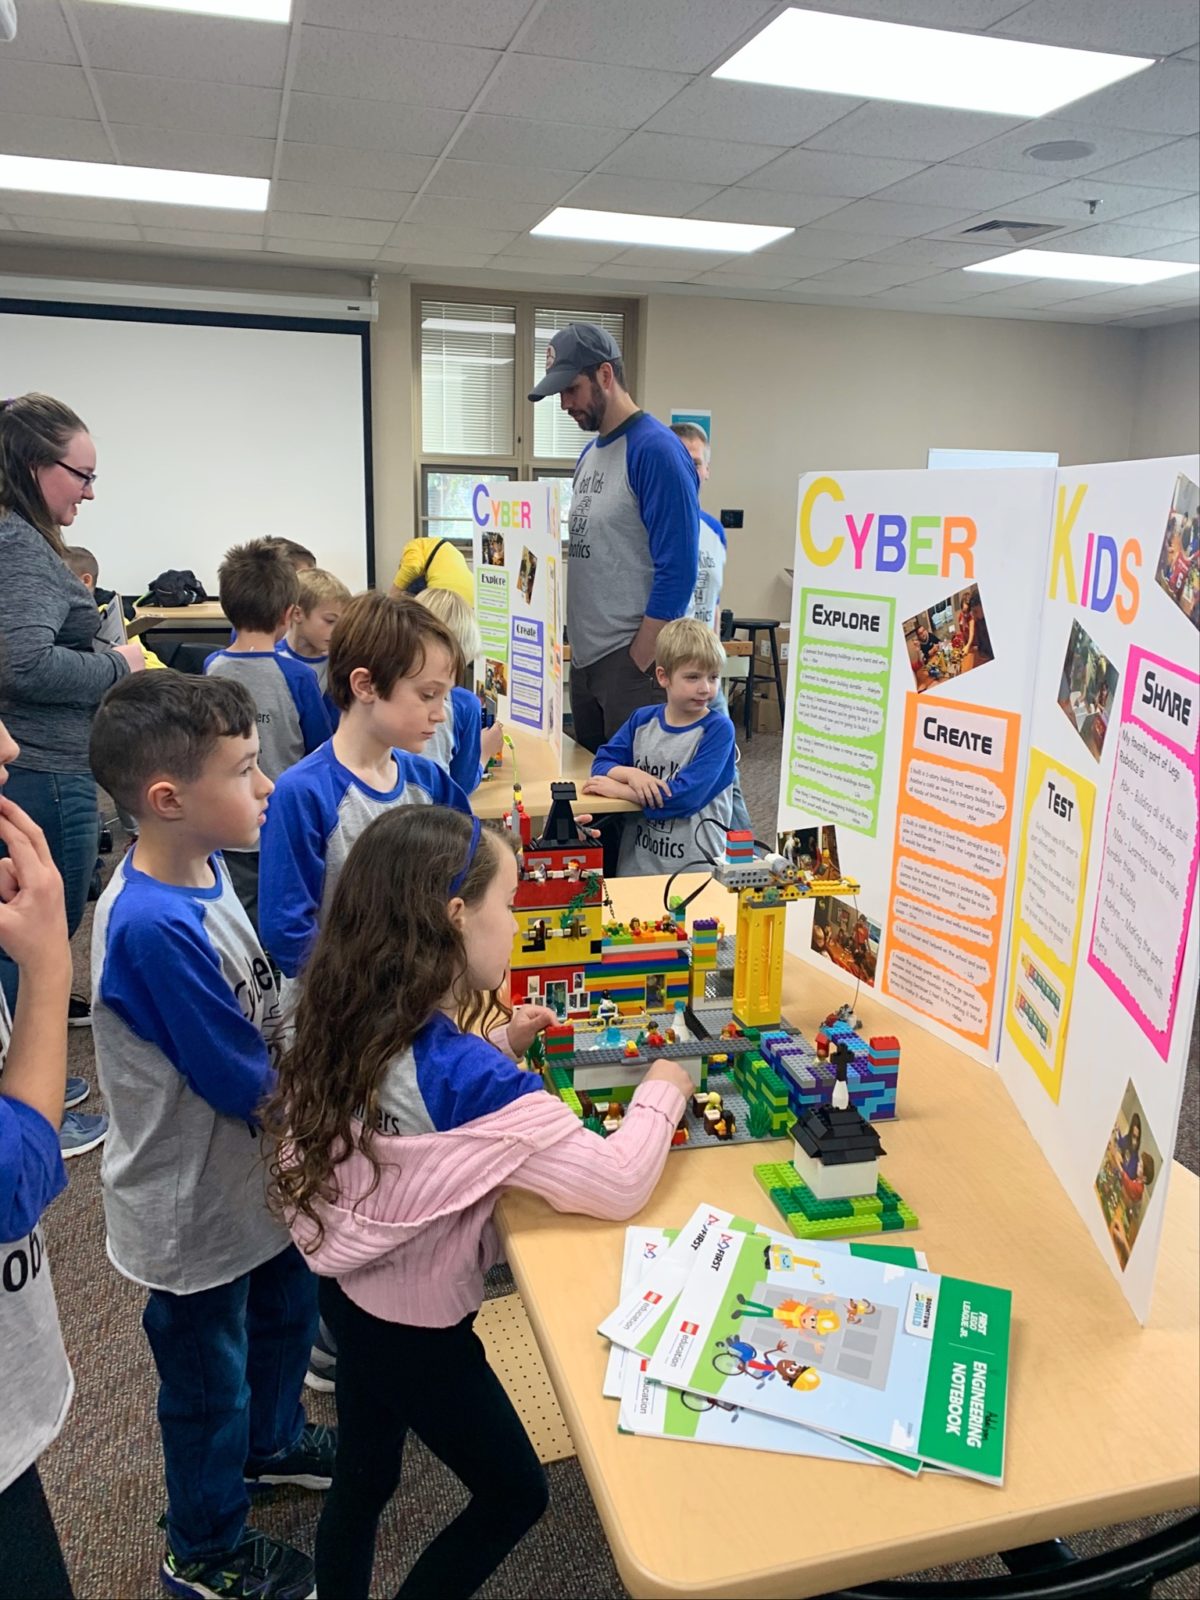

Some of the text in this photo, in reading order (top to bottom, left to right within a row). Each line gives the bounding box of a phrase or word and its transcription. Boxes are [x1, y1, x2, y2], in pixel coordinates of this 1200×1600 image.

[472, 484, 531, 529] CYBER
[801, 476, 1143, 625] CYBER KIDS
[812, 604, 880, 632] EXPLORE
[1142, 671, 1192, 726] SHARE
[924, 717, 992, 755] CREATE
[1048, 781, 1074, 822] TEST
[635, 825, 685, 859] Robotics
[691, 1229, 708, 1251] FIRST
[711, 1249, 725, 1271] FIRST
[624, 1302, 650, 1330] education
[961, 1301, 971, 1327] LEAGUE
[969, 1312, 979, 1331] LEGO
[978, 1312, 988, 1336] FIRST
[670, 1335, 688, 1367] education
[946, 1362, 966, 1436] NOTEBOOK
[966, 1361, 987, 1448] ENGINEERING
